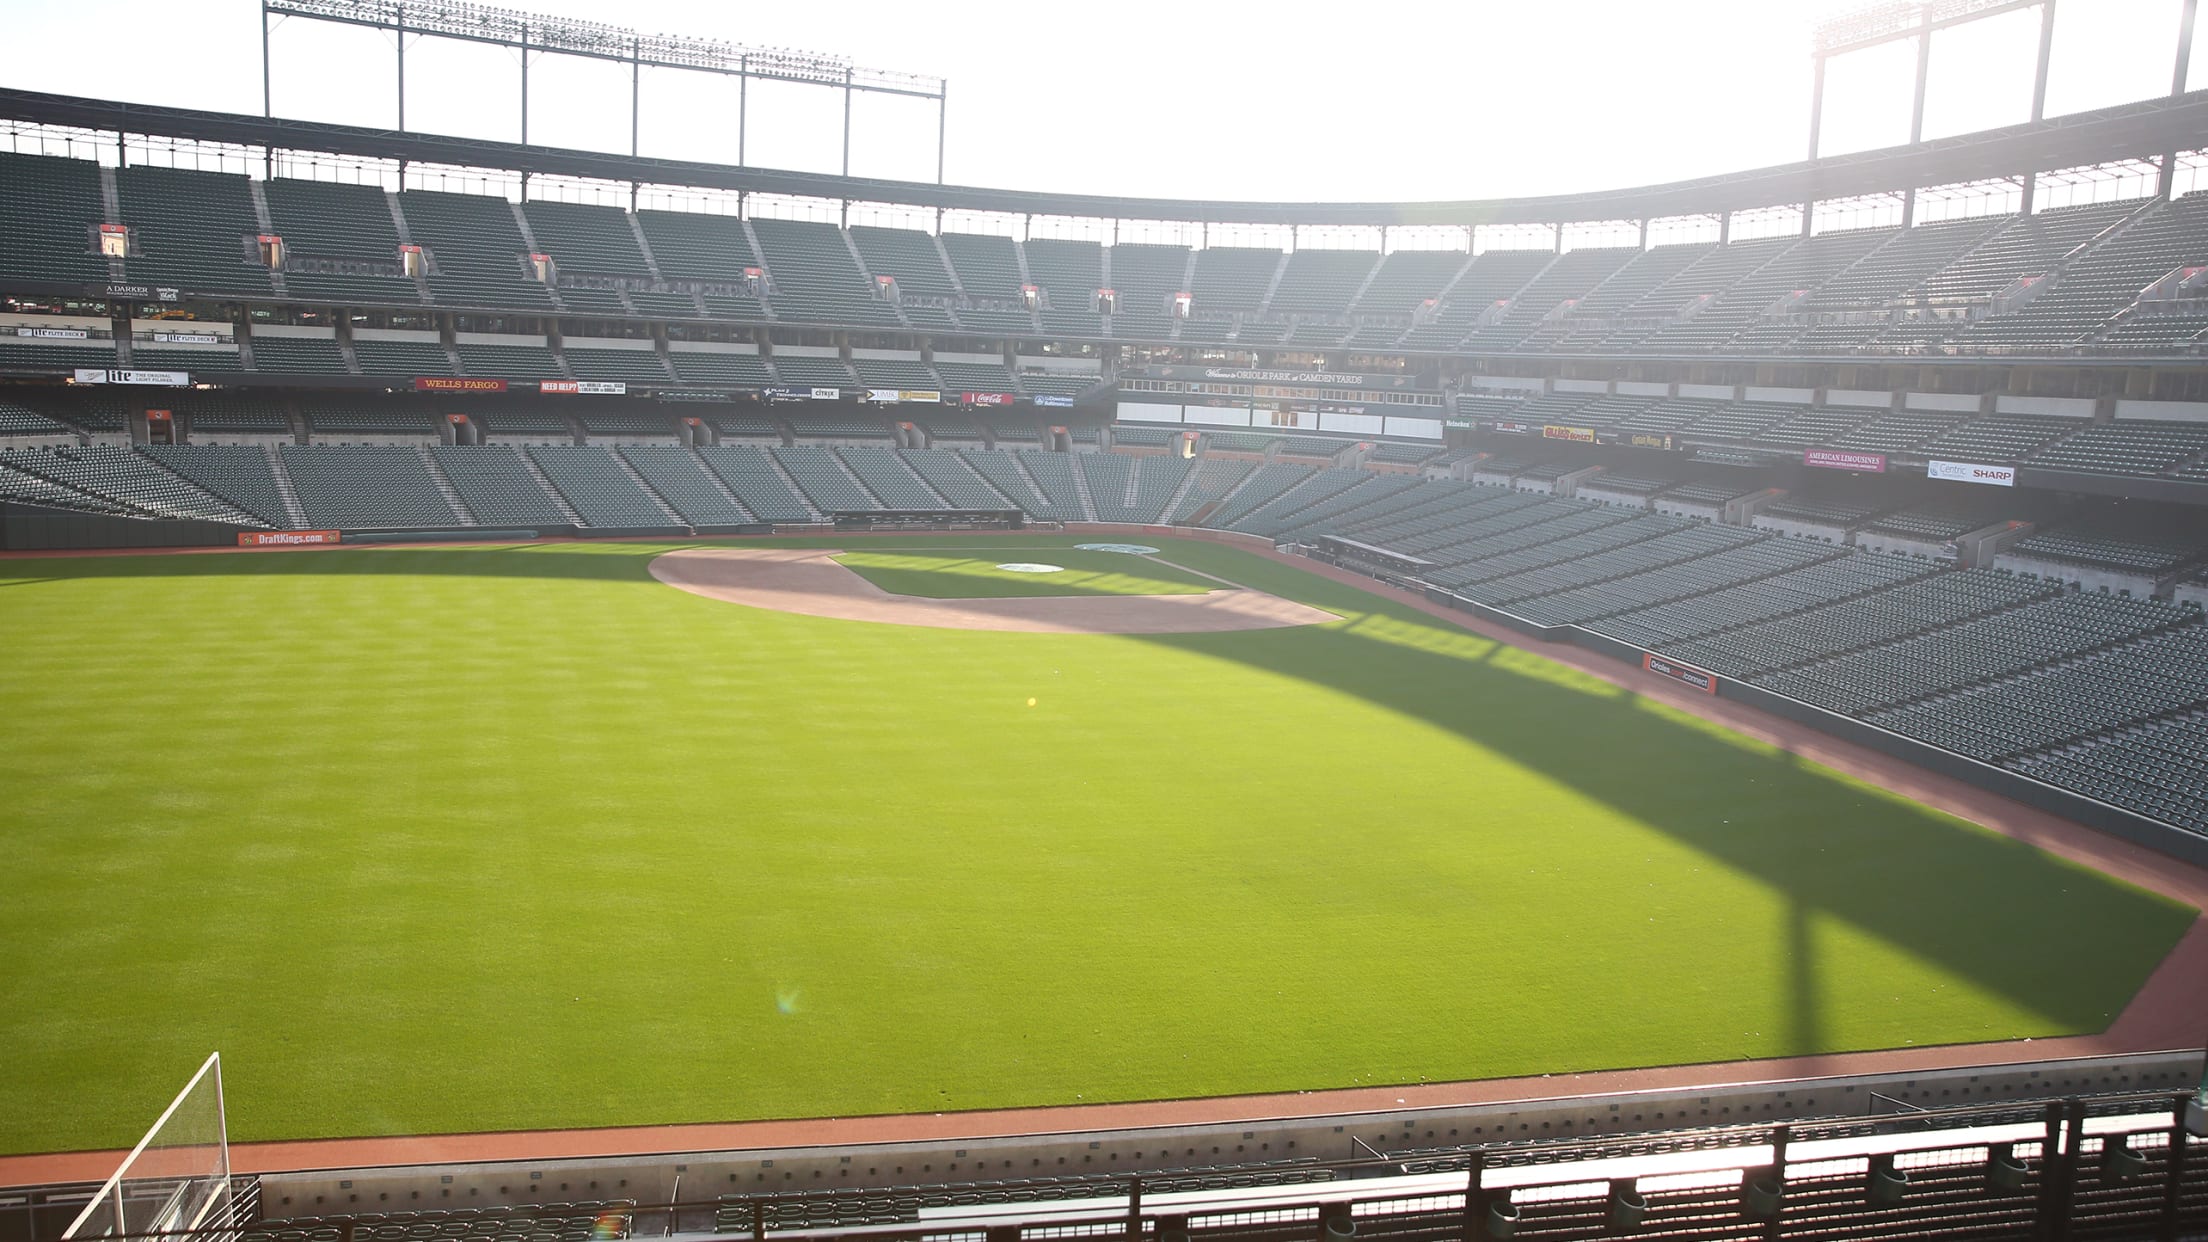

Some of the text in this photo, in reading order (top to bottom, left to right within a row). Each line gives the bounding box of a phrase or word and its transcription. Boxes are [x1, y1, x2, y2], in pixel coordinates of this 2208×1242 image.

[1236, 370, 1268, 380] ORIOLE
[1269, 372, 1290, 381] PARK
[1300, 373, 1335, 383] CAMDEN
[1335, 375, 1362, 384] YARDS
[425, 379, 499, 389] WELLS FARGO
[542, 382, 558, 391] NEED
[559, 383, 577, 391] HELP?
[1808, 452, 1840, 461] AMERICAN
[1841, 454, 1880, 465] LIMOUSINES
[1940, 463, 1967, 475] Centric
[1973, 469, 2012, 480] SHARP
[259, 533, 323, 544] DraftKings.com
